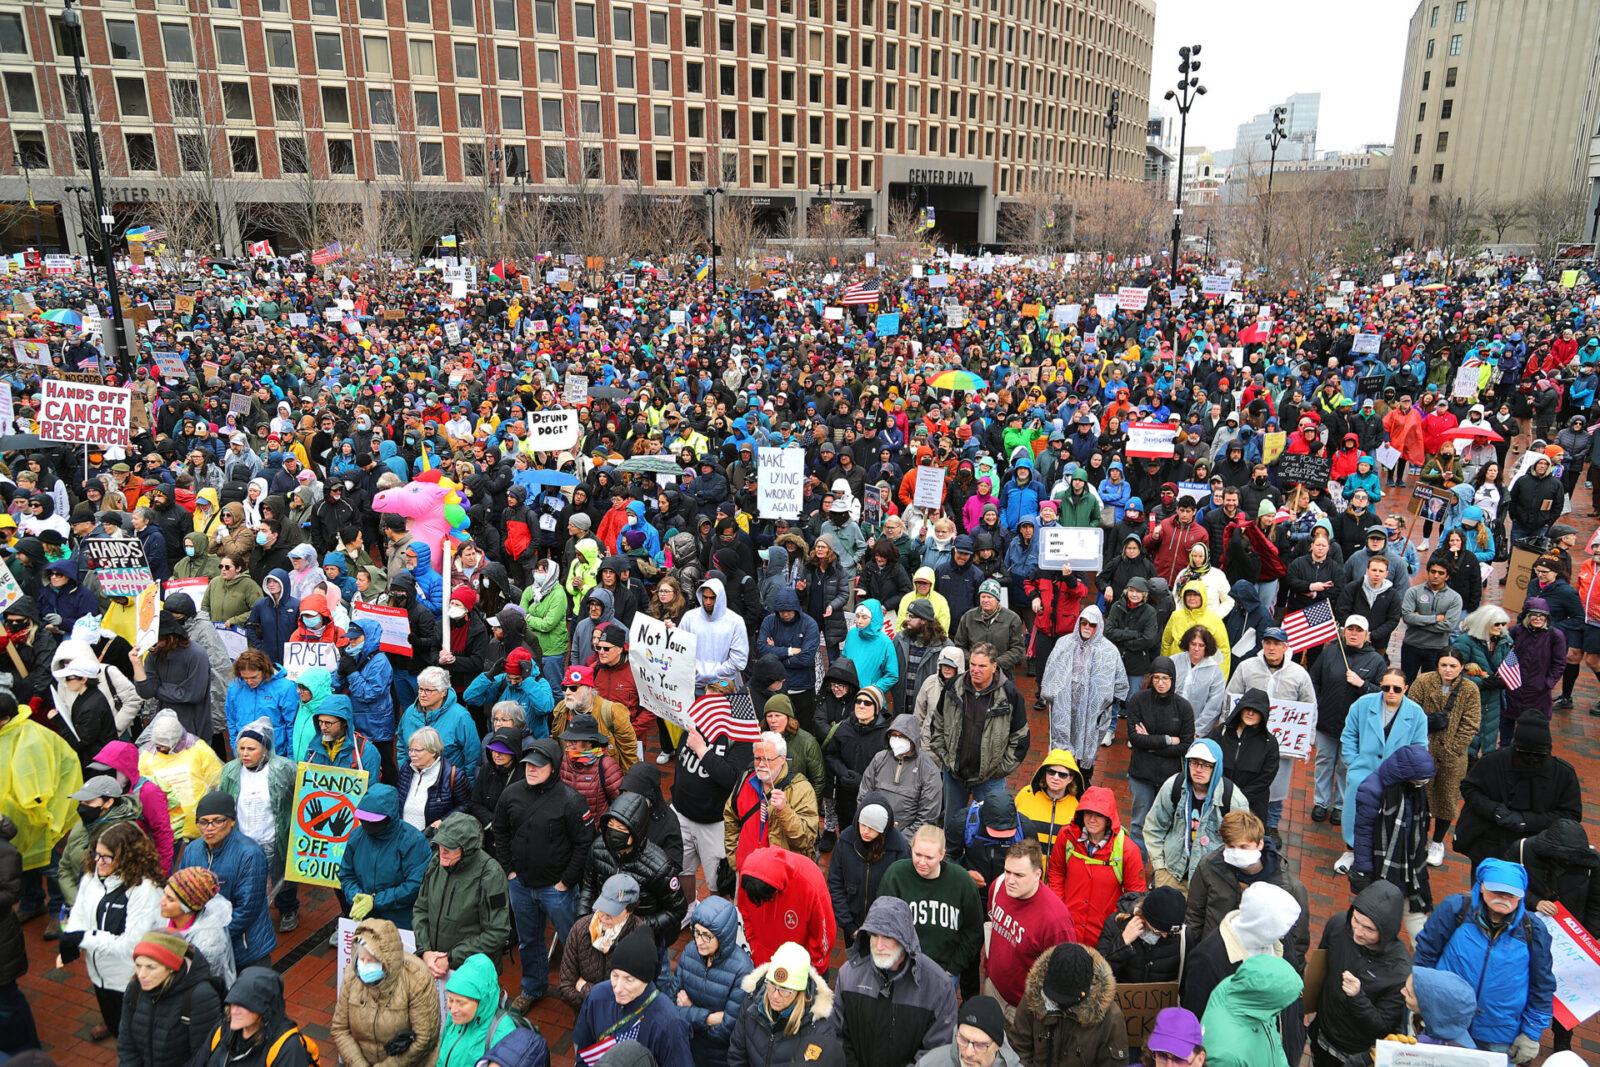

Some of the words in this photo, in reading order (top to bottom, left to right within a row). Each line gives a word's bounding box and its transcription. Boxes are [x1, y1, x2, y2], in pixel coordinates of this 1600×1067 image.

[909, 168, 944, 186] CENTER
[947, 170, 974, 188] PLAZA
[100, 187, 150, 201] ENTER
[65, 374, 75, 382] NO
[79, 374, 101, 384] GODS
[46, 382, 95, 401] HANDS
[98, 391, 128, 404] OFF
[45, 401, 127, 426] CANCER
[532, 413, 568, 424] DEFUND
[41, 421, 128, 446] RESEARCH
[757, 453, 785, 468] MAKE
[1300, 455, 1329, 467] POWER
[770, 471, 800, 485] LYING
[1284, 466, 1318, 477] GREATER
[764, 489, 796, 500] WRONG
[1416, 486, 1433, 494] ALEXA
[771, 502, 798, 512] AGAIN
[88, 541, 144, 559] HANDS
[97, 567, 151, 580] TRANS
[637, 623, 661, 646] Not
[664, 627, 687, 654] Your
[289, 642, 328, 667] RISE
[639, 666, 655, 683] Not
[658, 672, 679, 692] Your
[647, 685, 683, 712] Fucking
[1281, 706, 1310, 725] THE
[1272, 727, 1308, 751] PLE
[302, 771, 362, 795] HANDS
[332, 843, 345, 857] th
[296, 857, 340, 881] COUR
[992, 904, 1025, 944] MASS
[1114, 989, 1172, 1010] ASCISM
[1125, 1015, 1154, 1038] CK
